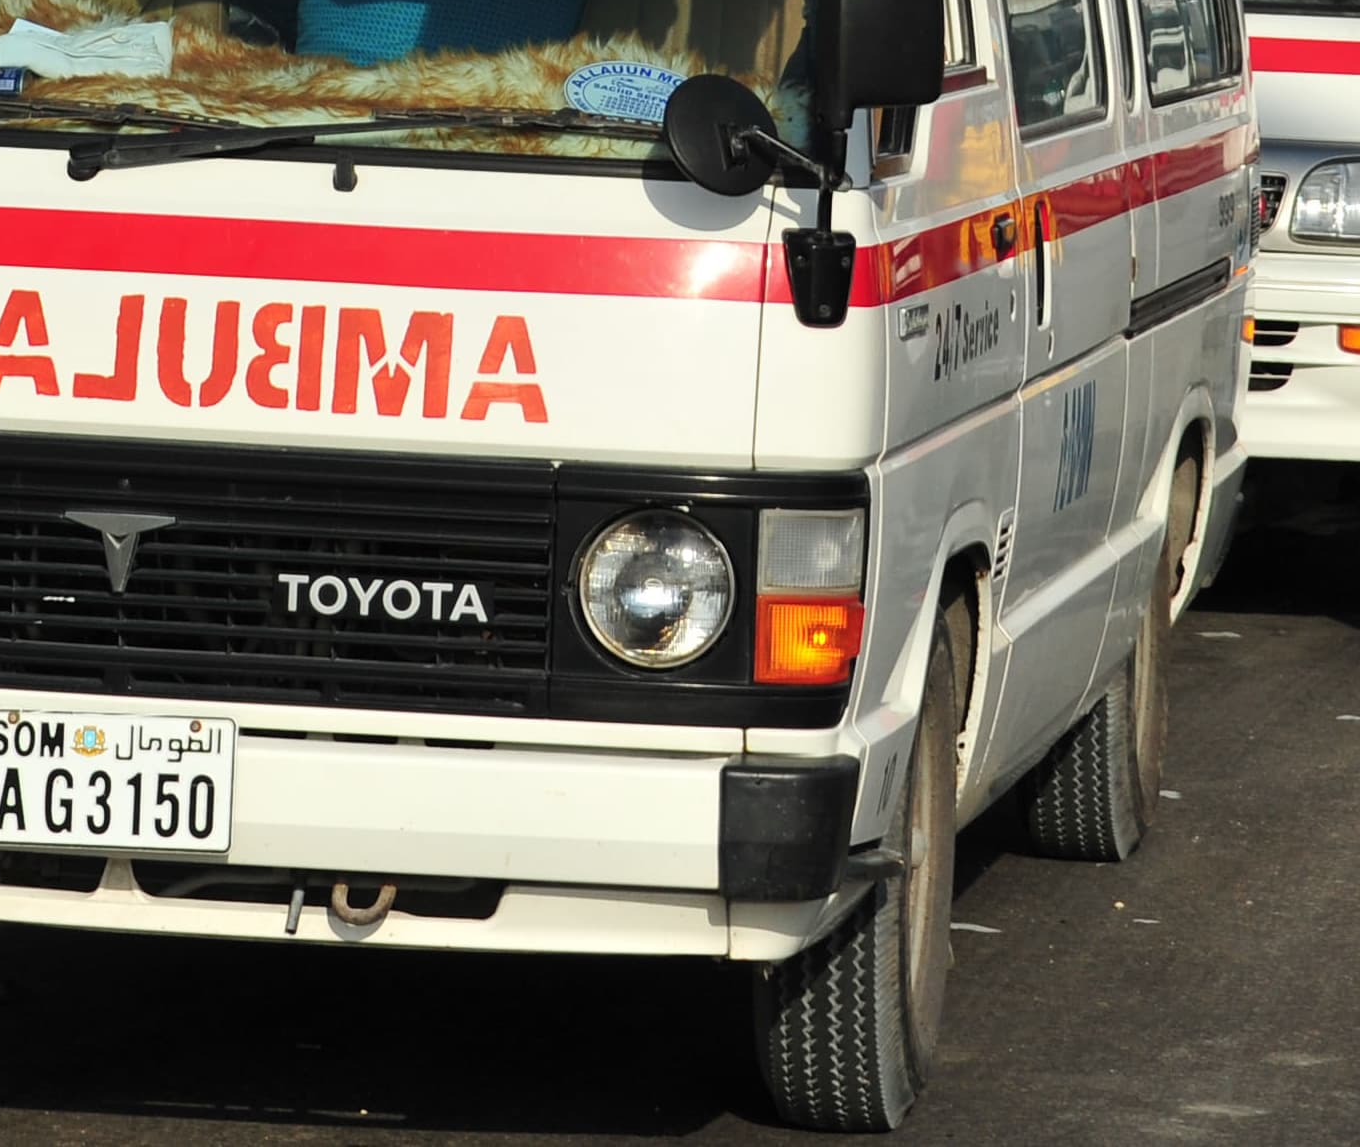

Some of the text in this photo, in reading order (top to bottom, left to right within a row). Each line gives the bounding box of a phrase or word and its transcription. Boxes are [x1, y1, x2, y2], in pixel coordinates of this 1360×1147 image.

[571, 65, 652, 89] ALLAUUN
[934, 300, 999, 381] 24/7 Service
[277, 571, 489, 624] TOYOTA
